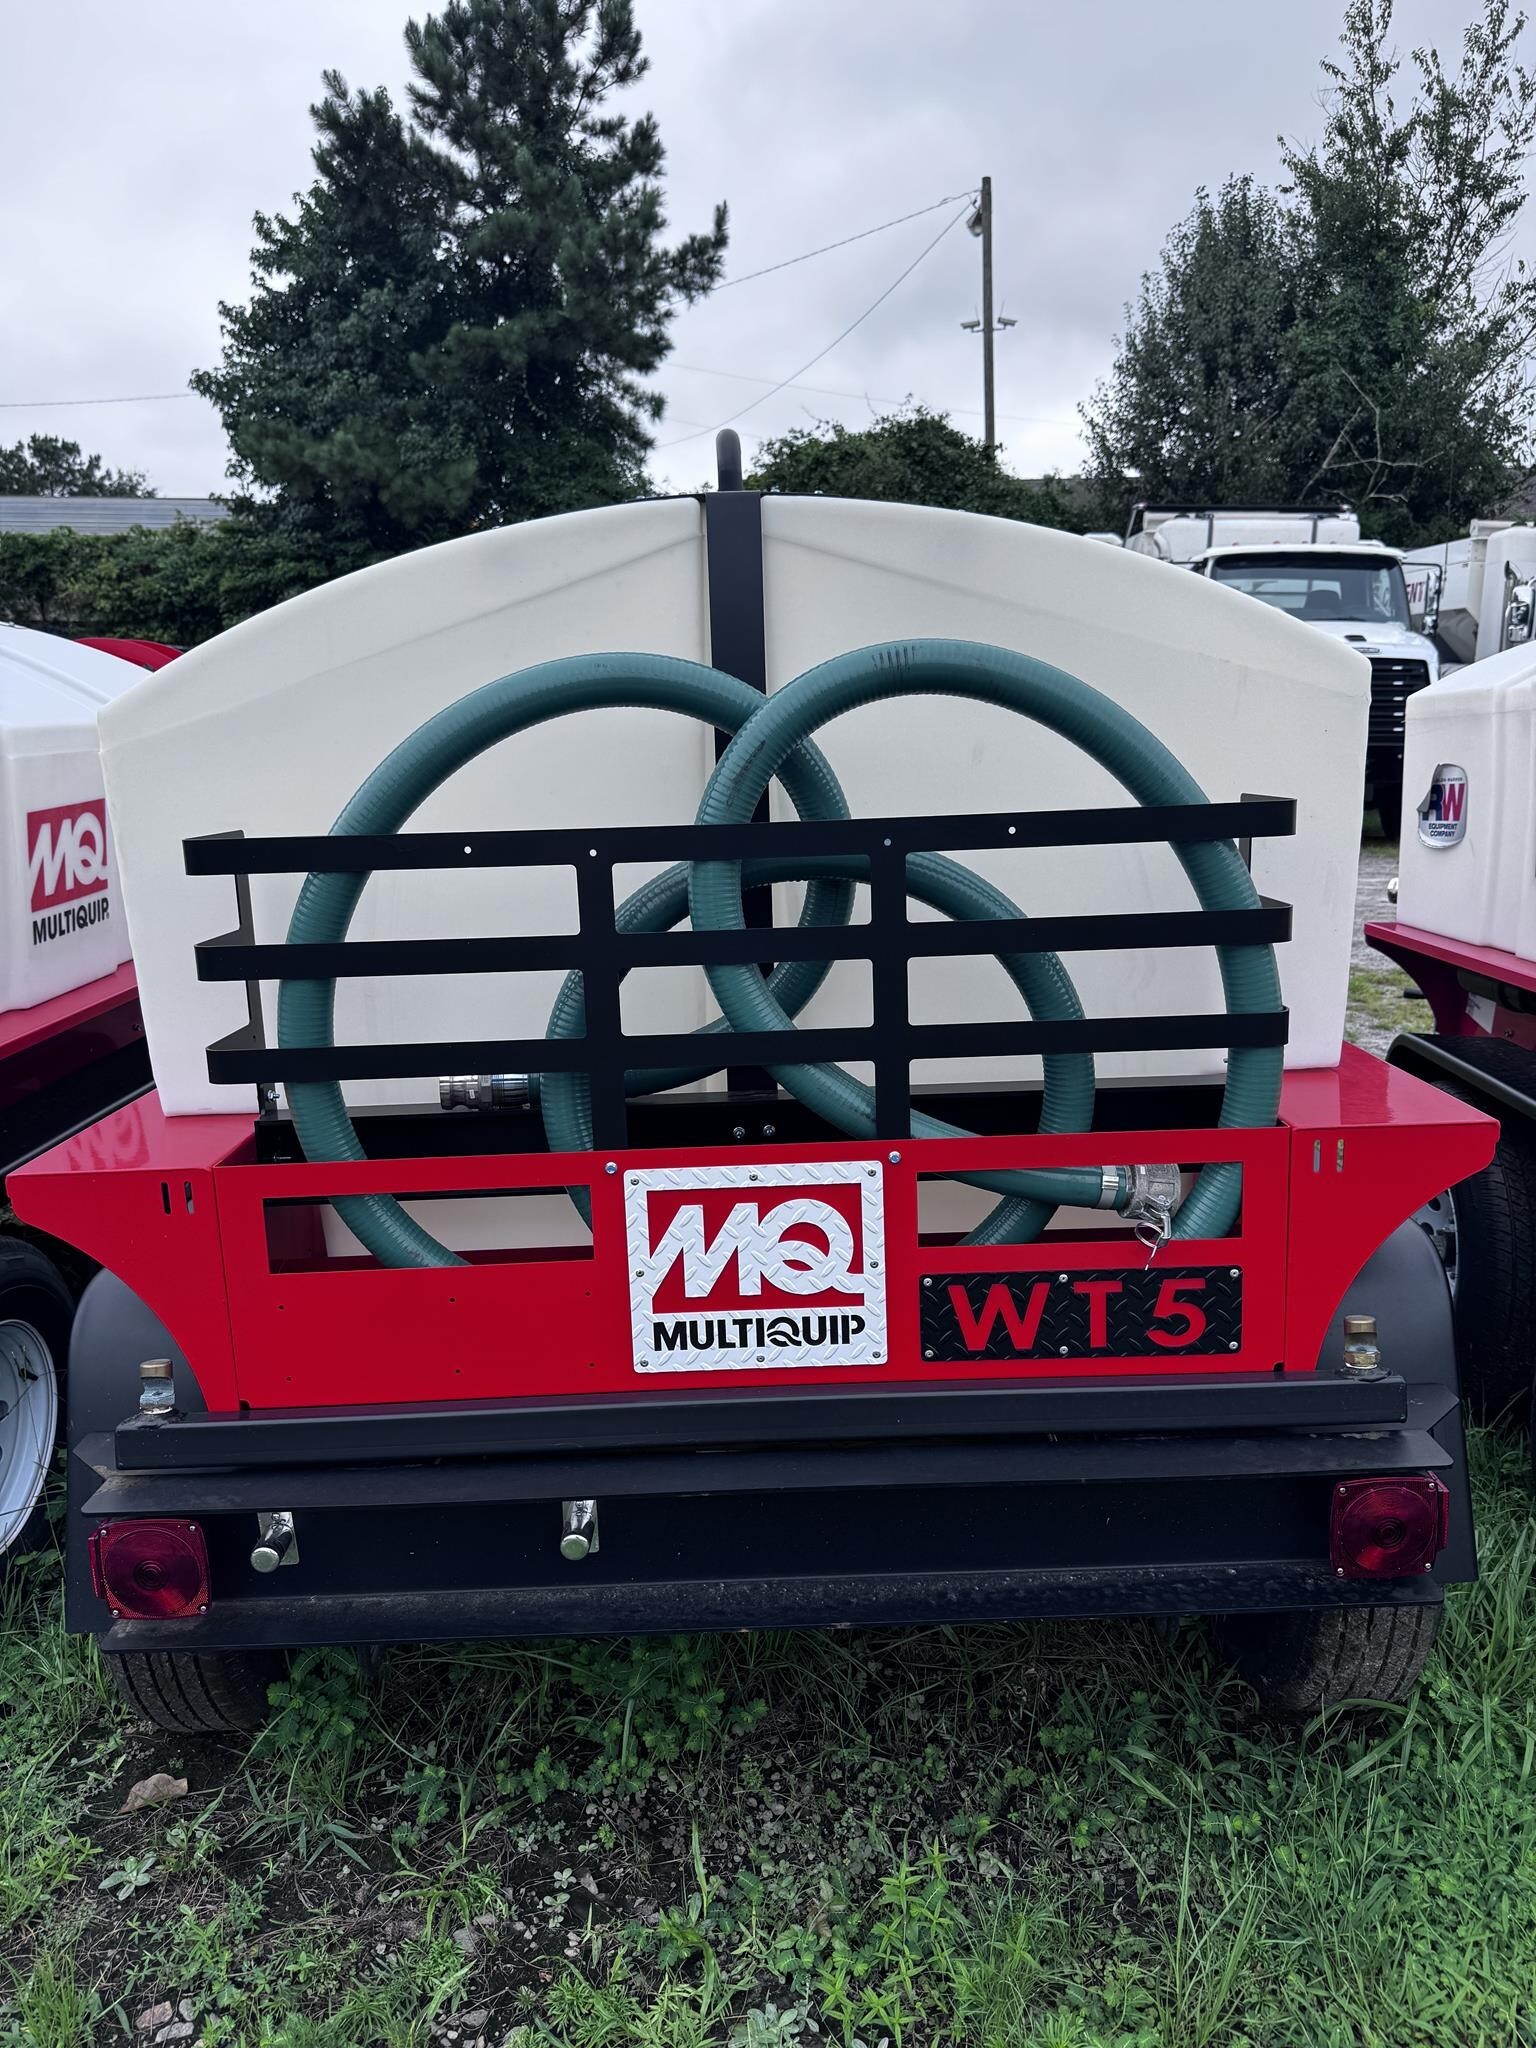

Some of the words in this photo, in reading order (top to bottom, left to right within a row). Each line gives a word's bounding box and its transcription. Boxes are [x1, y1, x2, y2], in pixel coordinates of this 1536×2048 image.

[1428, 823, 1458, 831] EQUIPMENT
[1429, 830, 1456, 838] COMPANY
[29, 811, 108, 897] MQ
[32, 897, 109, 946] MULTIQUIP
[650, 1198, 865, 1299] MQ
[652, 1314, 866, 1352] MULTIQUIP
